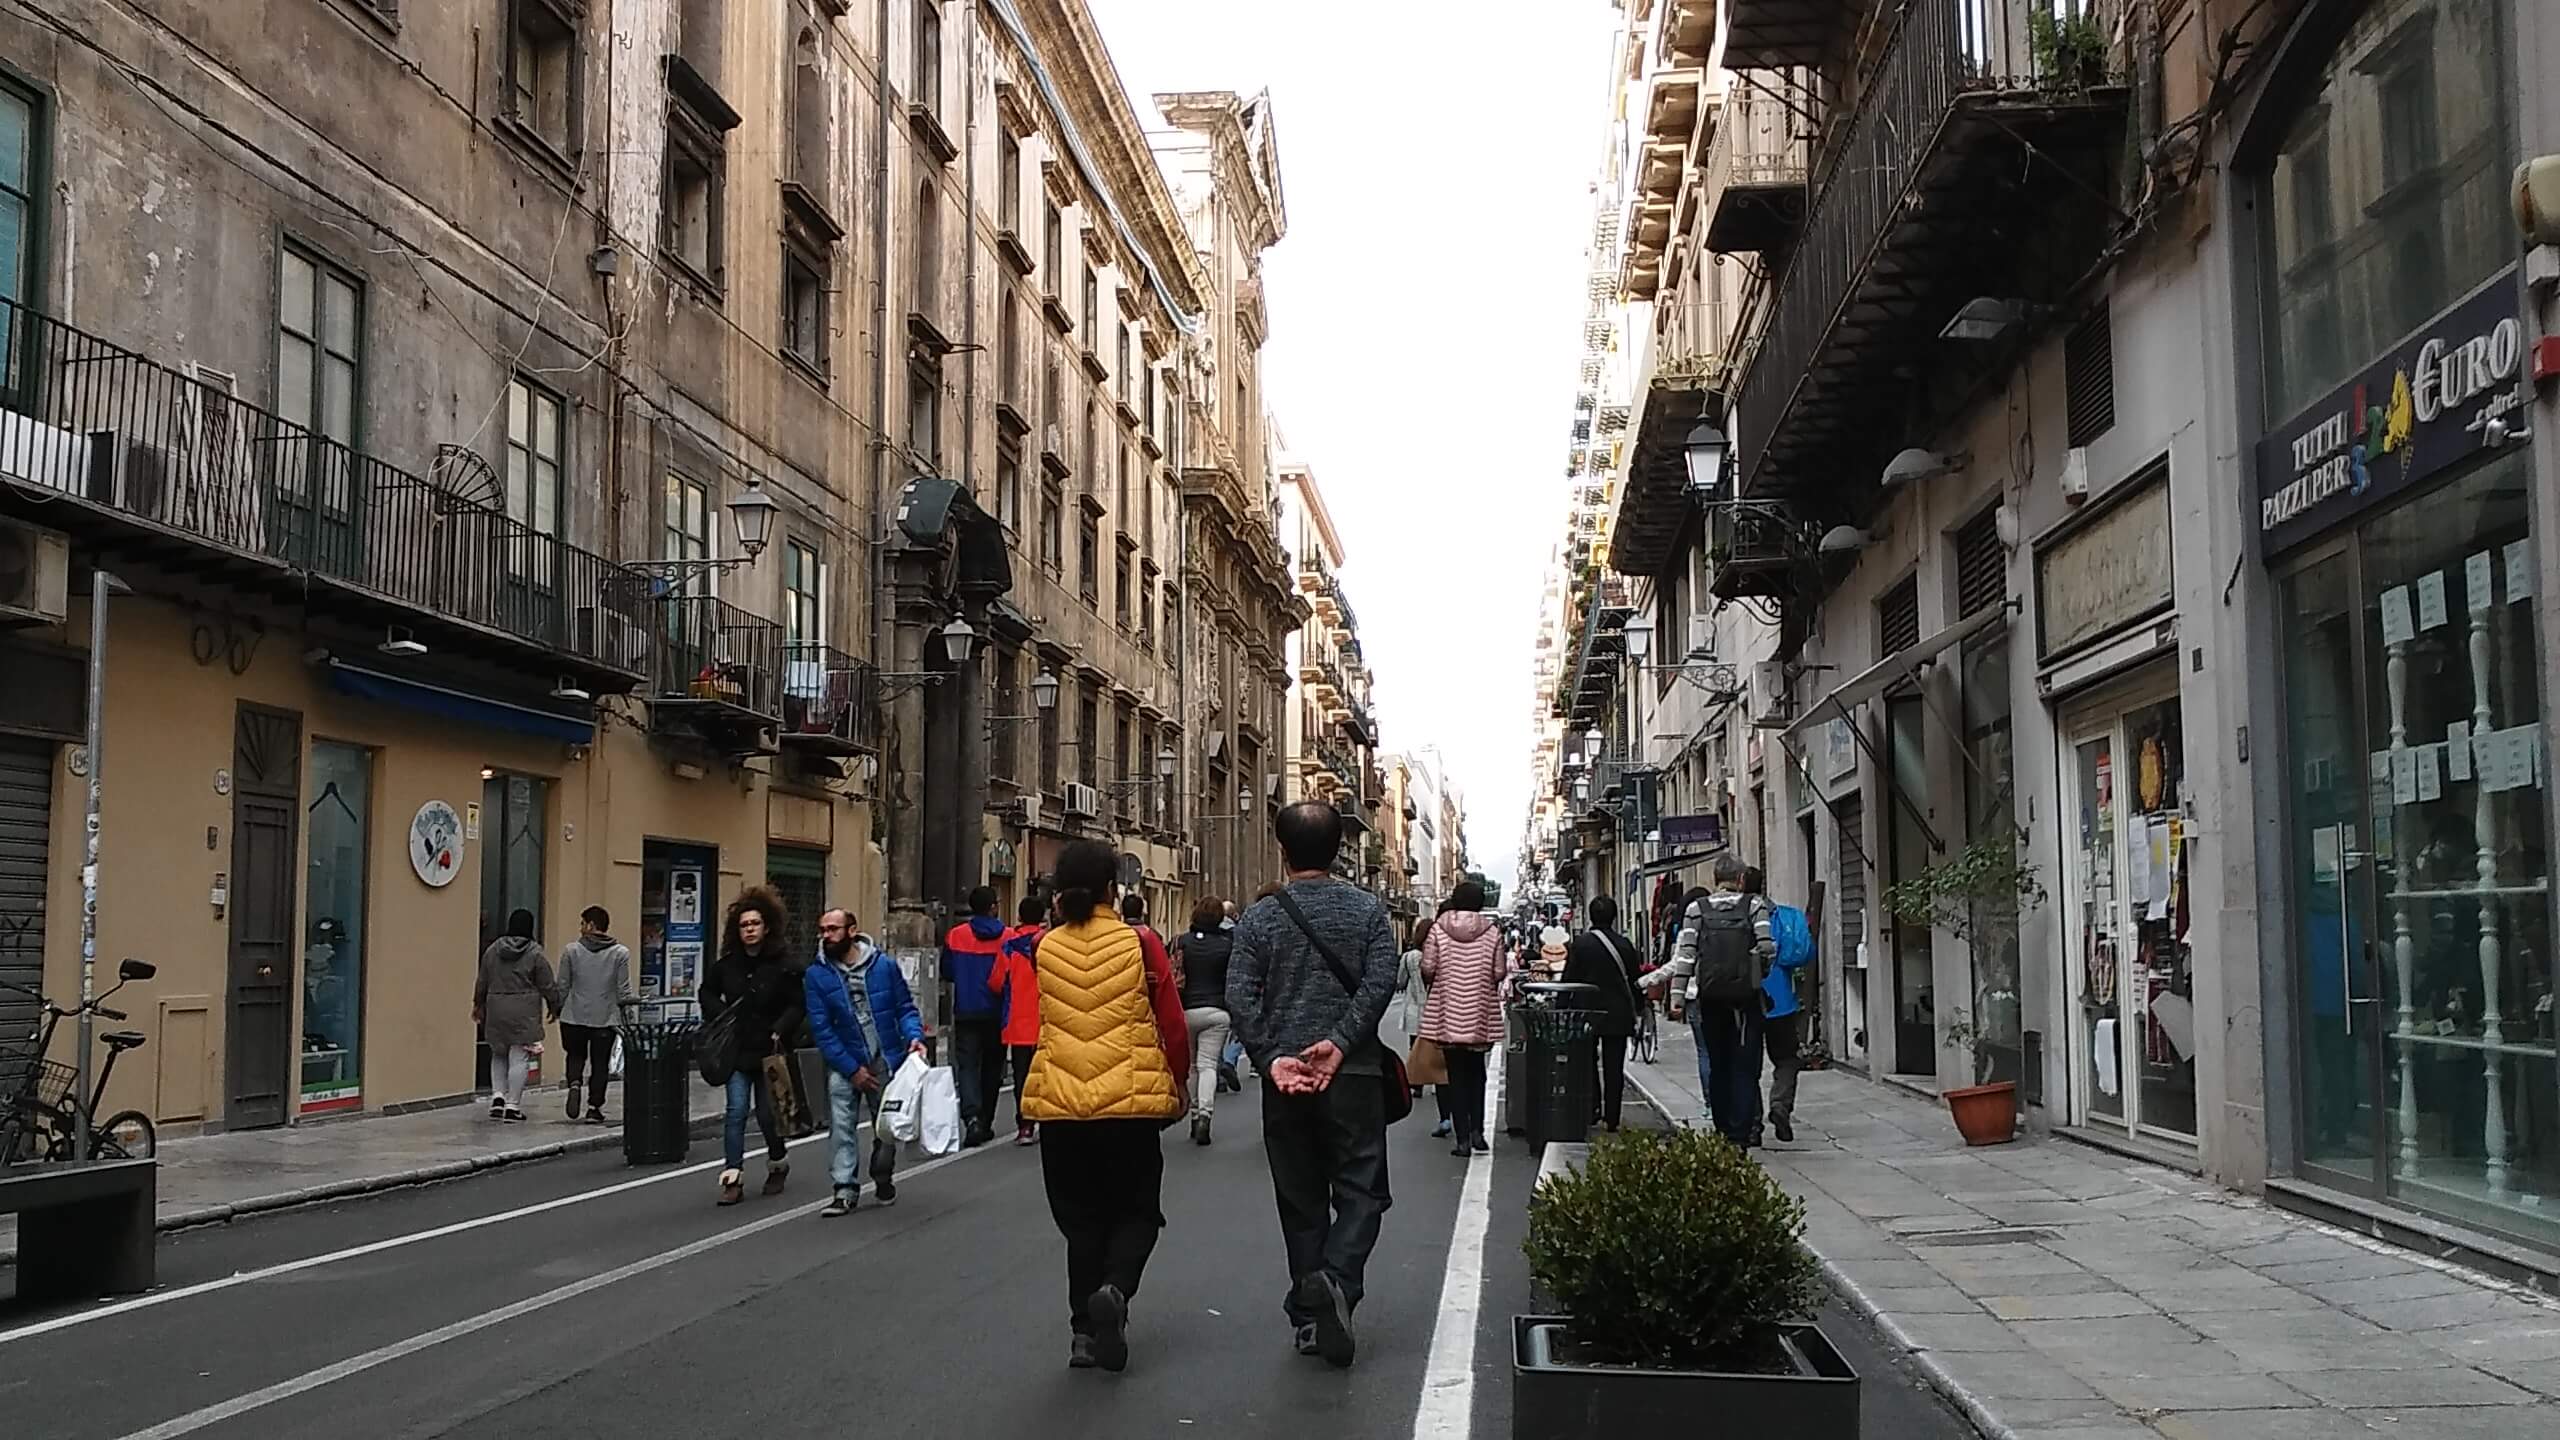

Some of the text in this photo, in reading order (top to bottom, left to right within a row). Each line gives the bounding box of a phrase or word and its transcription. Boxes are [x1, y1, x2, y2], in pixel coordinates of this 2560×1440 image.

[2292, 410, 2349, 472] TUTTI
[2262, 455, 2352, 531] PAZZI PER
